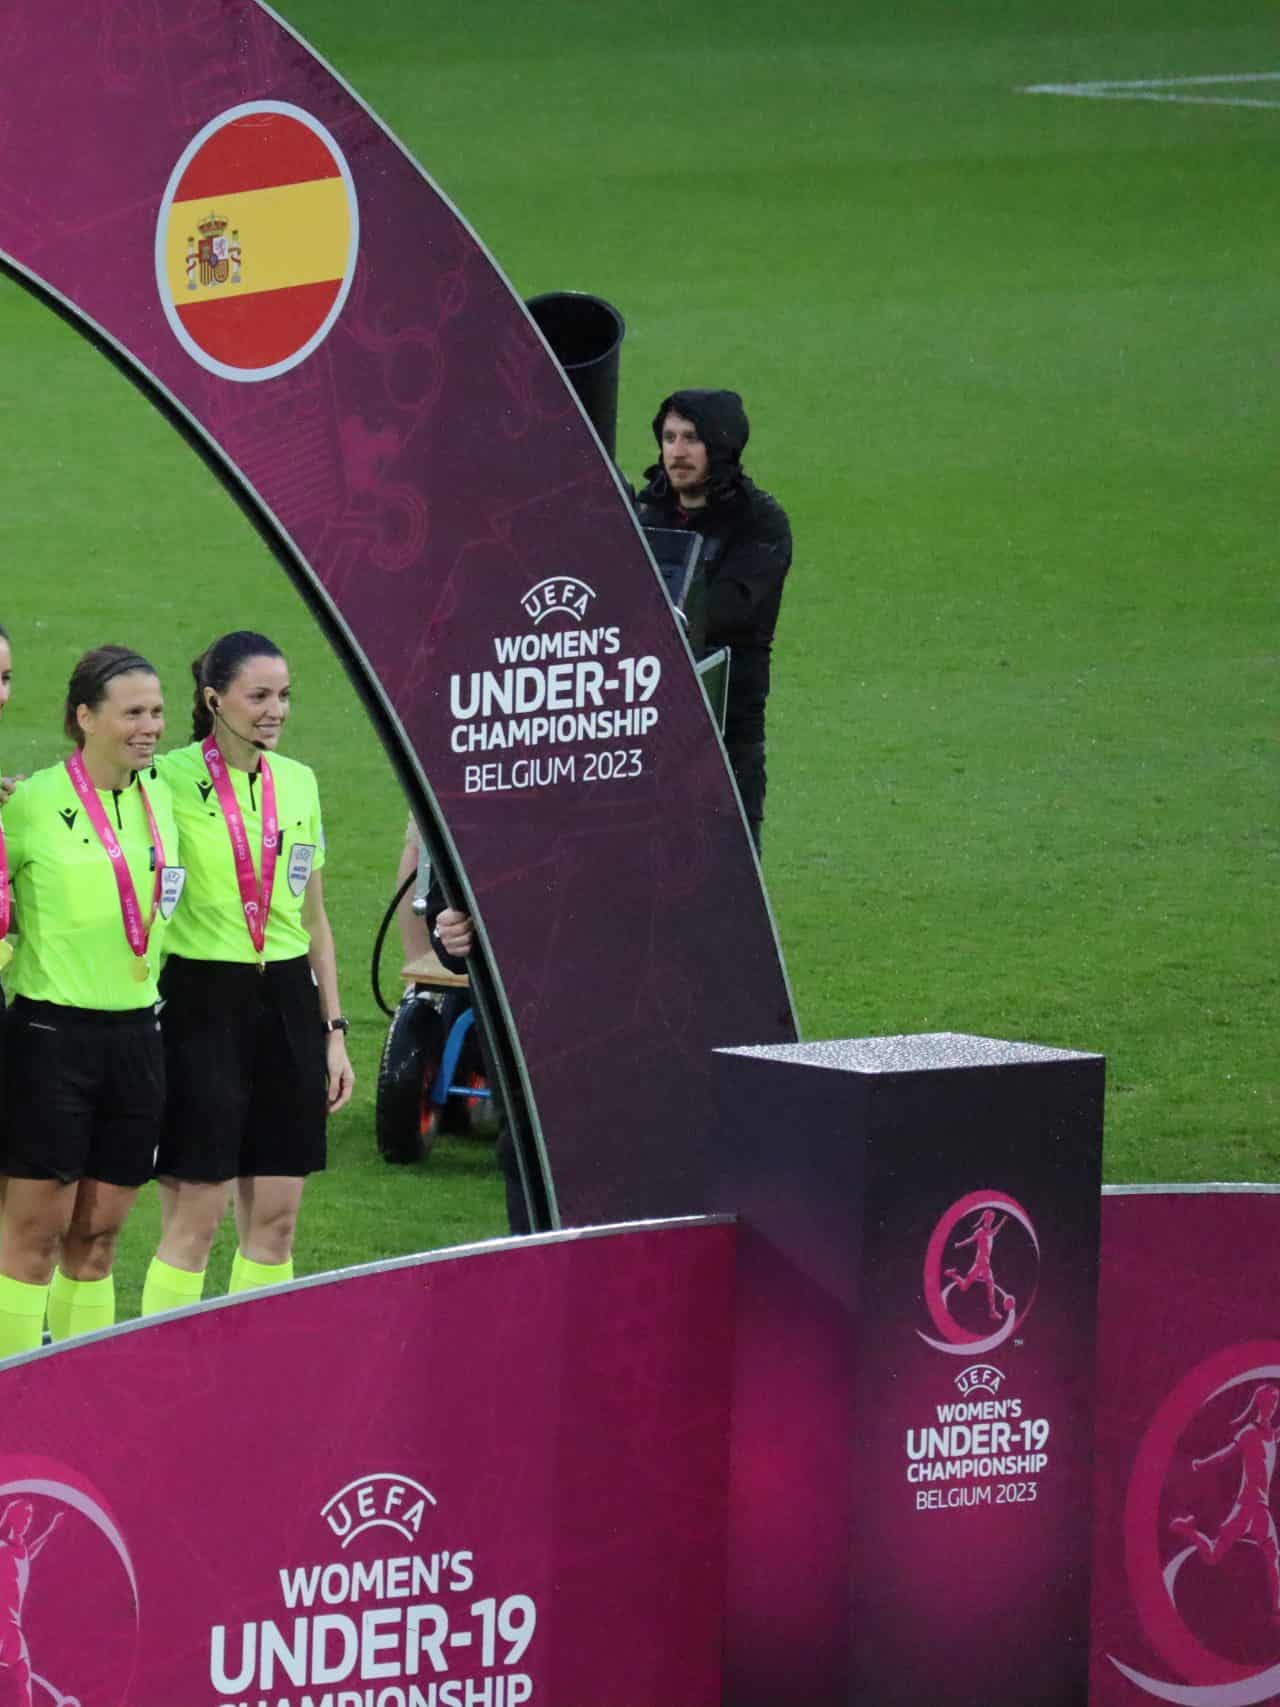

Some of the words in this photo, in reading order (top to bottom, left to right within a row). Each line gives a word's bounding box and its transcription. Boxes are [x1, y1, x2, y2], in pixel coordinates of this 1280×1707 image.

[524, 584, 589, 617] UEFA
[494, 626, 621, 664] WOMEN'S
[450, 655, 661, 720] UNDER-19
[450, 706, 659, 753] CHAMPIONSHIP
[464, 755, 576, 794] BELGIUM
[582, 749, 643, 781] 2023
[957, 1369, 1001, 1393] UEFA
[936, 1399, 1022, 1424] WOMEN'S
[906, 1418, 1050, 1461] UNDER-19
[907, 1453, 1048, 1483] CHAMPIONSHIP
[326, 1485, 425, 1536] UEFA
[916, 1486, 991, 1510] BELGIUM
[996, 1482, 1037, 1504] 2023
[279, 1550, 474, 1609] WOMEN'S
[210, 1594, 537, 1695] UNDER-19
